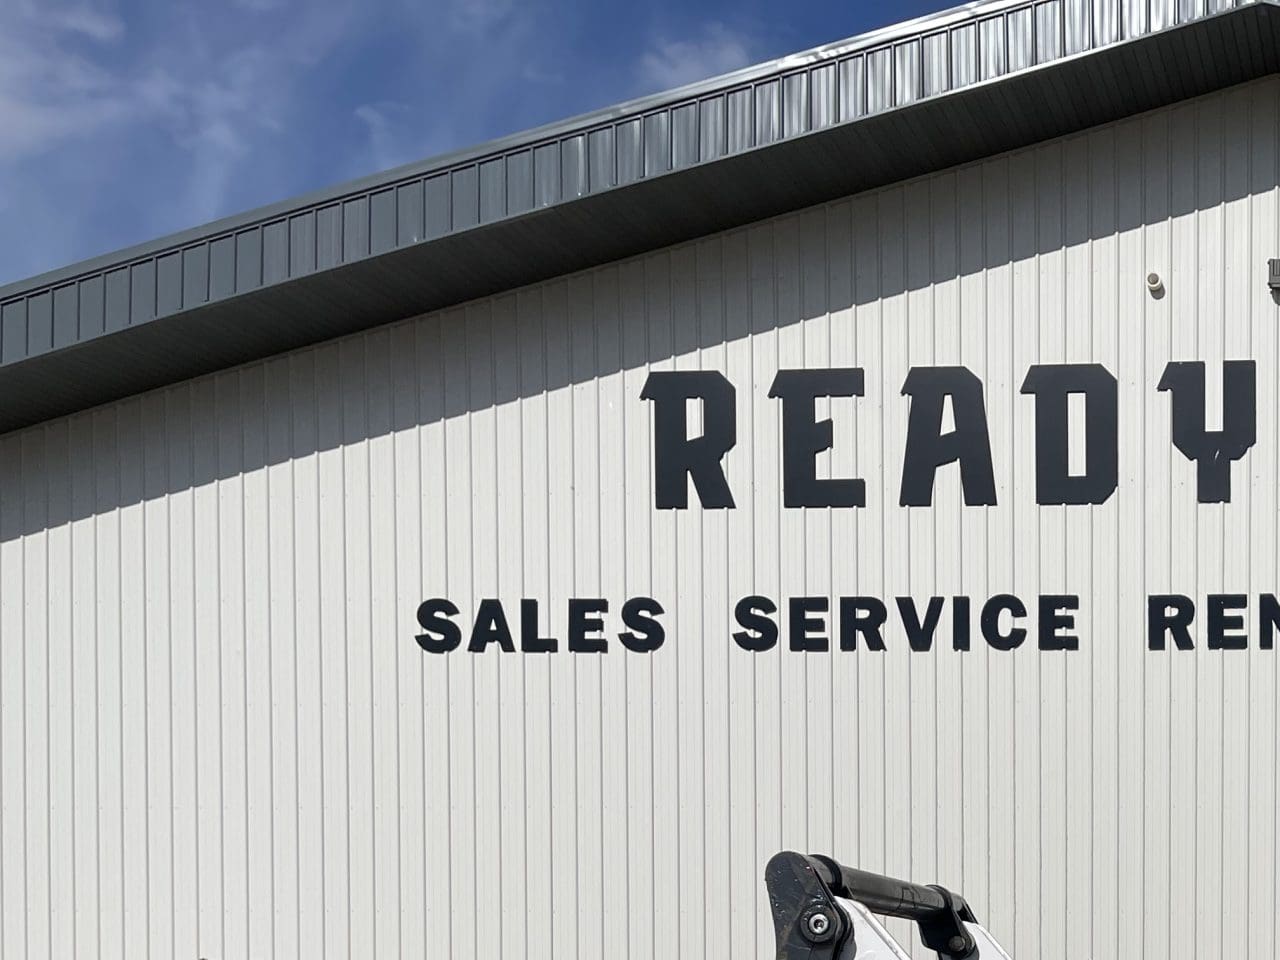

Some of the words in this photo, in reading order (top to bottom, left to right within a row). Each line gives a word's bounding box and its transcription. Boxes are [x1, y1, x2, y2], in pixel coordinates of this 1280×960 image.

[640, 360, 1256, 509] READY
[415, 598, 665, 653] SALES
[733, 595, 1078, 652] SERVICE
